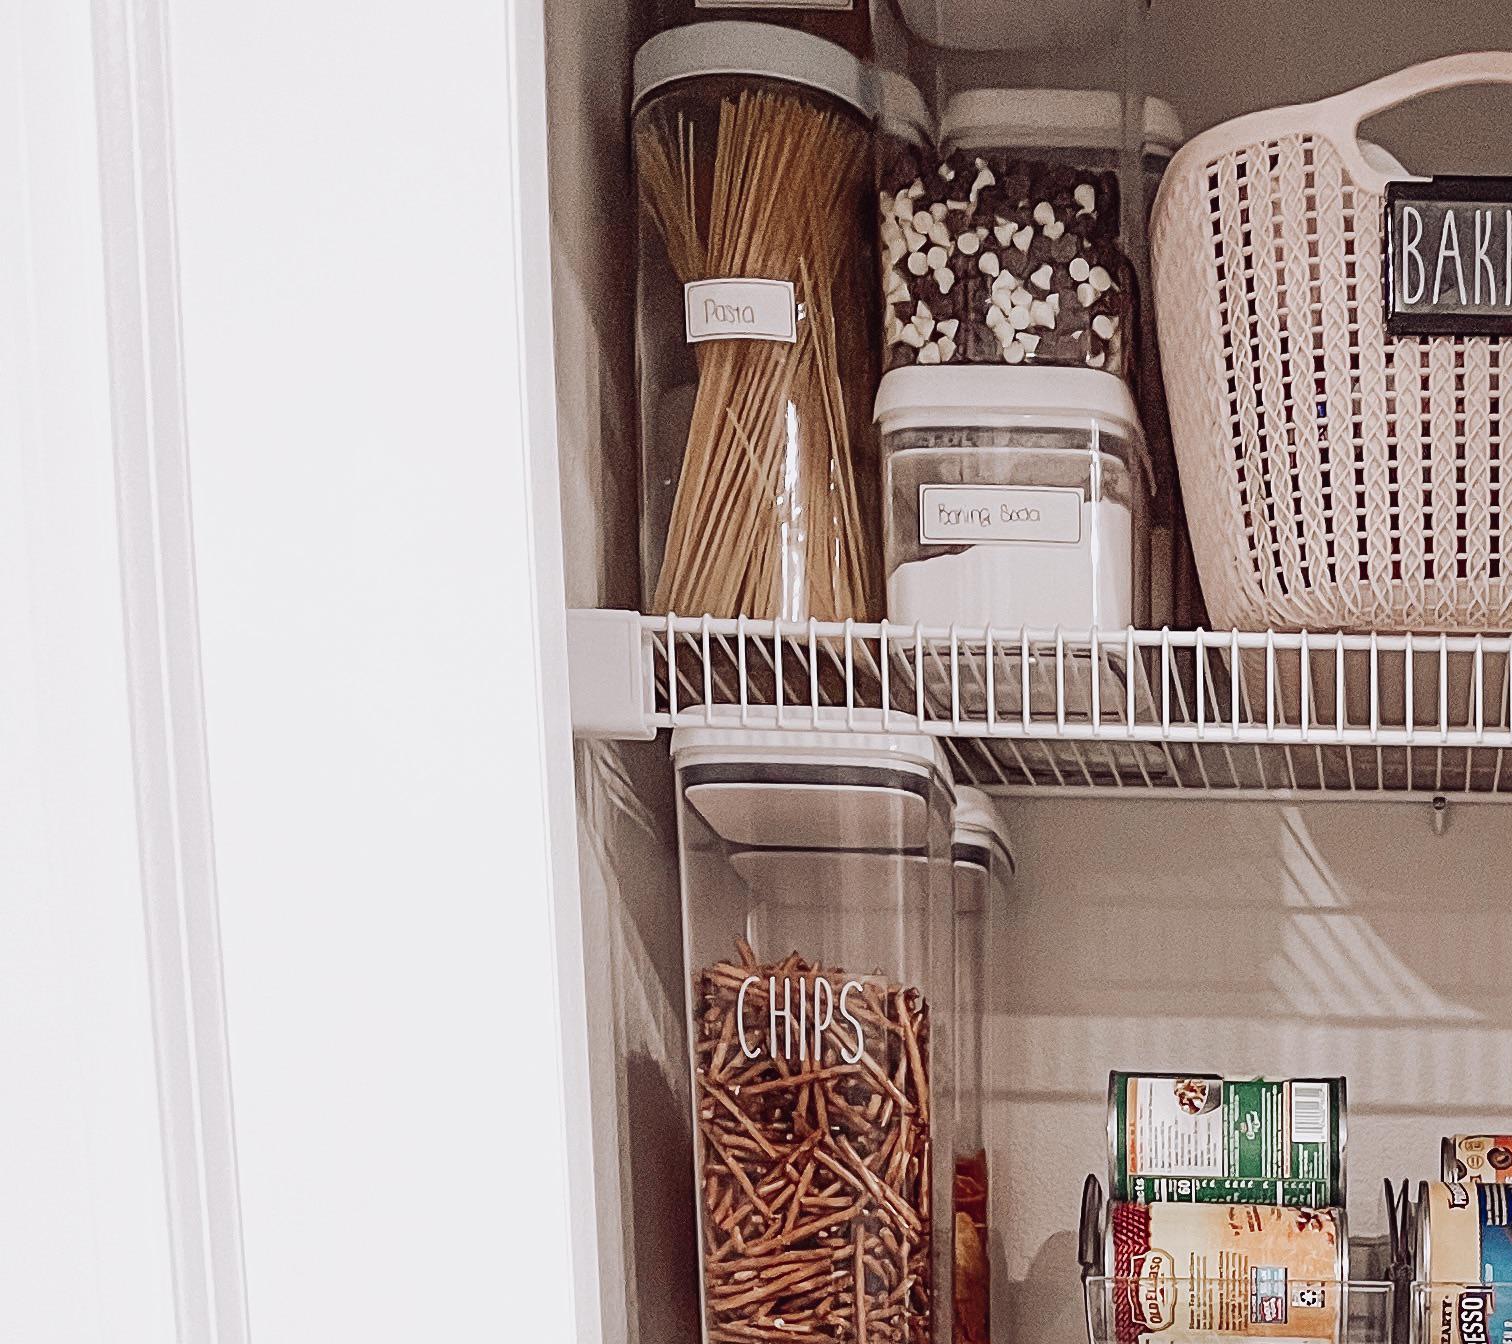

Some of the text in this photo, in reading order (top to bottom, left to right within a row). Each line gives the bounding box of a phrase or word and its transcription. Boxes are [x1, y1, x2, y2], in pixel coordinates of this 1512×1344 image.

[704, 298, 755, 324] Pasta
[737, 975, 865, 1065] CHIPS
[1146, 1256, 1162, 1287] ASO
